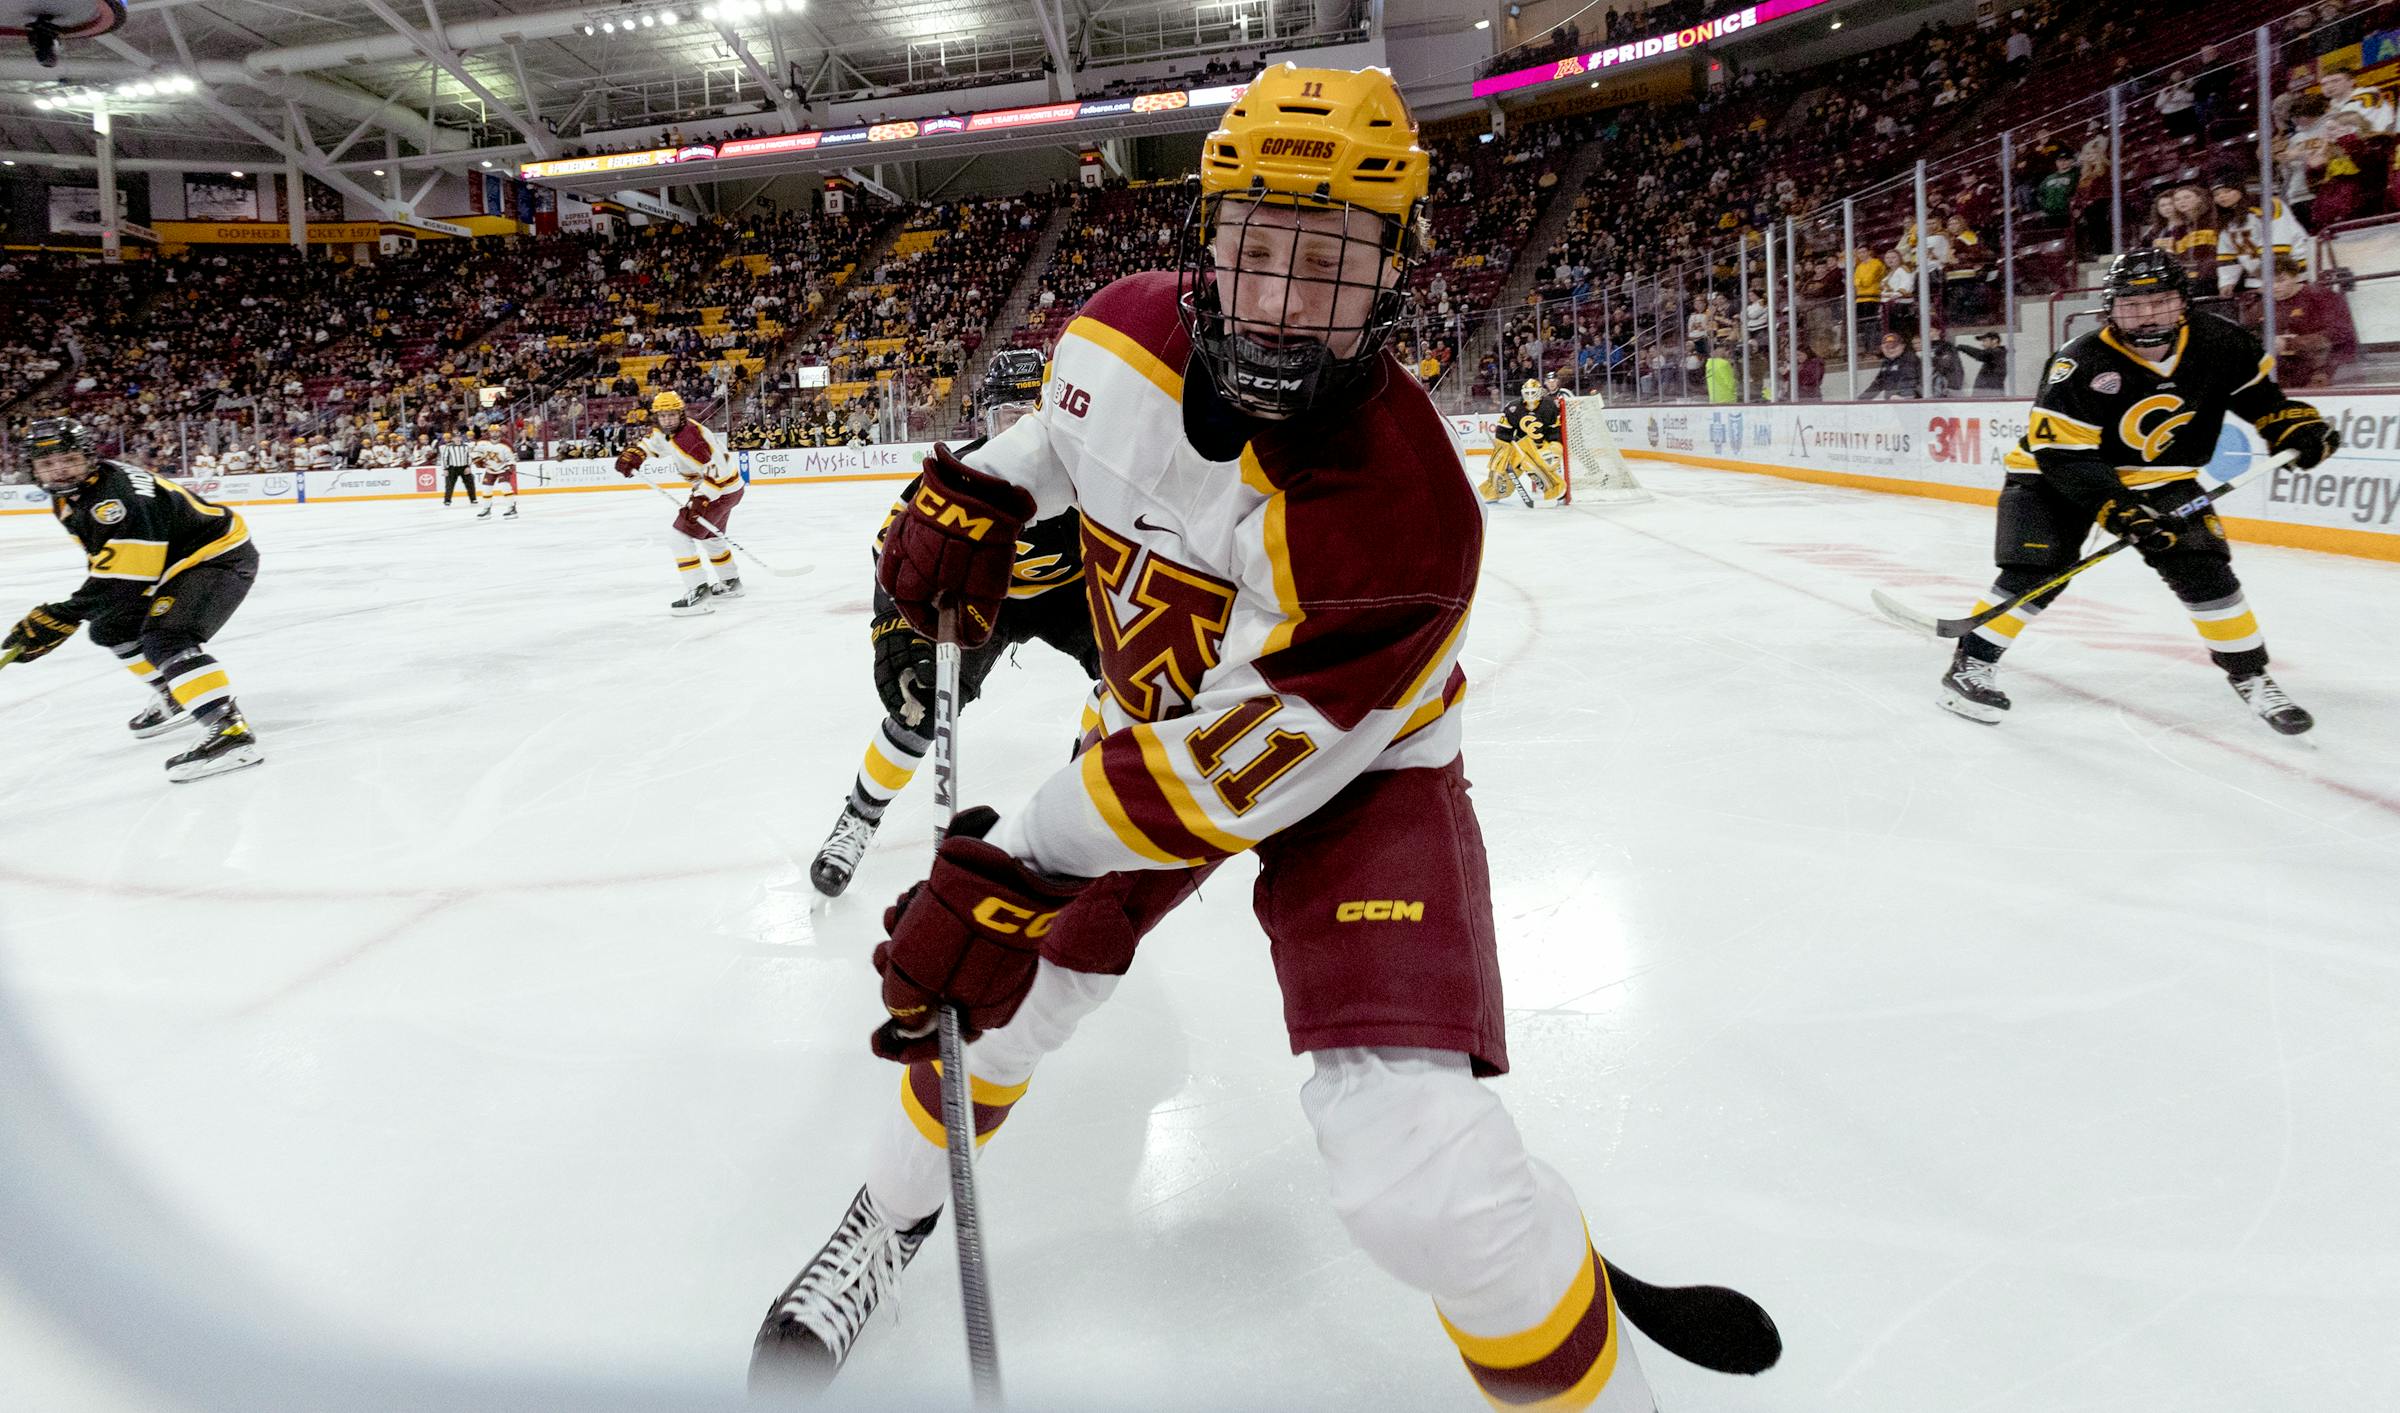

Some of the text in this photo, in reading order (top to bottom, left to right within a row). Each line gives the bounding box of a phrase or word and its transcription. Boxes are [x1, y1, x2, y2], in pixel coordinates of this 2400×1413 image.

[1587, 8, 1758, 71] #PRIDEONICE
[1301, 81, 1323, 98] 11
[1261, 137, 1336, 159] GOPHERS
[217, 227, 281, 240] GOPHER
[1015, 381, 1041, 389] TIGERS
[1234, 372, 1303, 391] CCM
[1989, 418, 2028, 438] Scie
[2035, 417, 2057, 442] 4
[1815, 431, 1911, 453] AFFINITY PLUS
[1928, 416, 1982, 464] 3M
[755, 452, 790, 463] Great
[759, 464, 787, 477] Clips
[2269, 465, 2400, 525] Energy
[967, 604, 991, 632] CCM
[1185, 694, 1317, 817] 11
[972, 896, 1060, 938] CC
[1336, 900, 1425, 922] CCM
